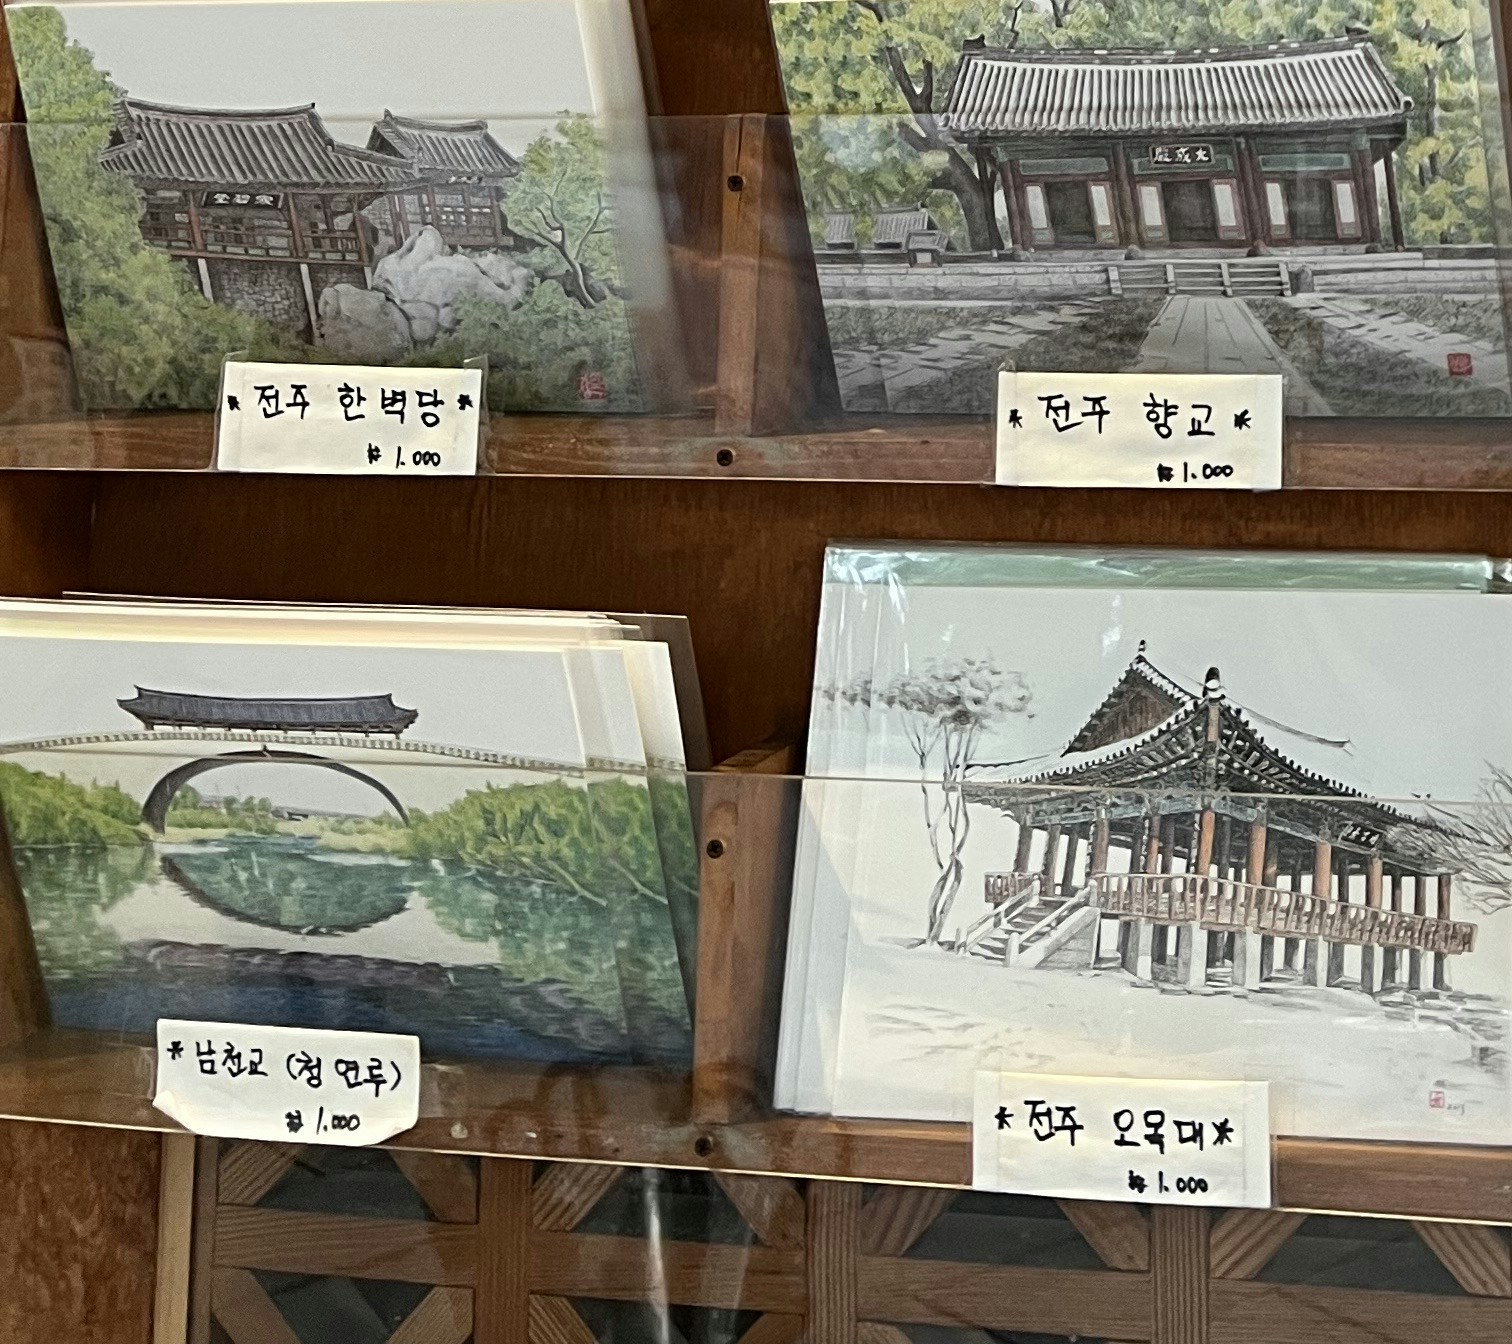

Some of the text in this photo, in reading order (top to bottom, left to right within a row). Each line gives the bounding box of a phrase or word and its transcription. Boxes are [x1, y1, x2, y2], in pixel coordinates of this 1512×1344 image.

[253, 383, 310, 420] 전주
[1037, 392, 1216, 439] 전주 향교
[195, 1039, 269, 1079] 남천교
[1023, 1099, 1205, 1155] 전주 오목대
